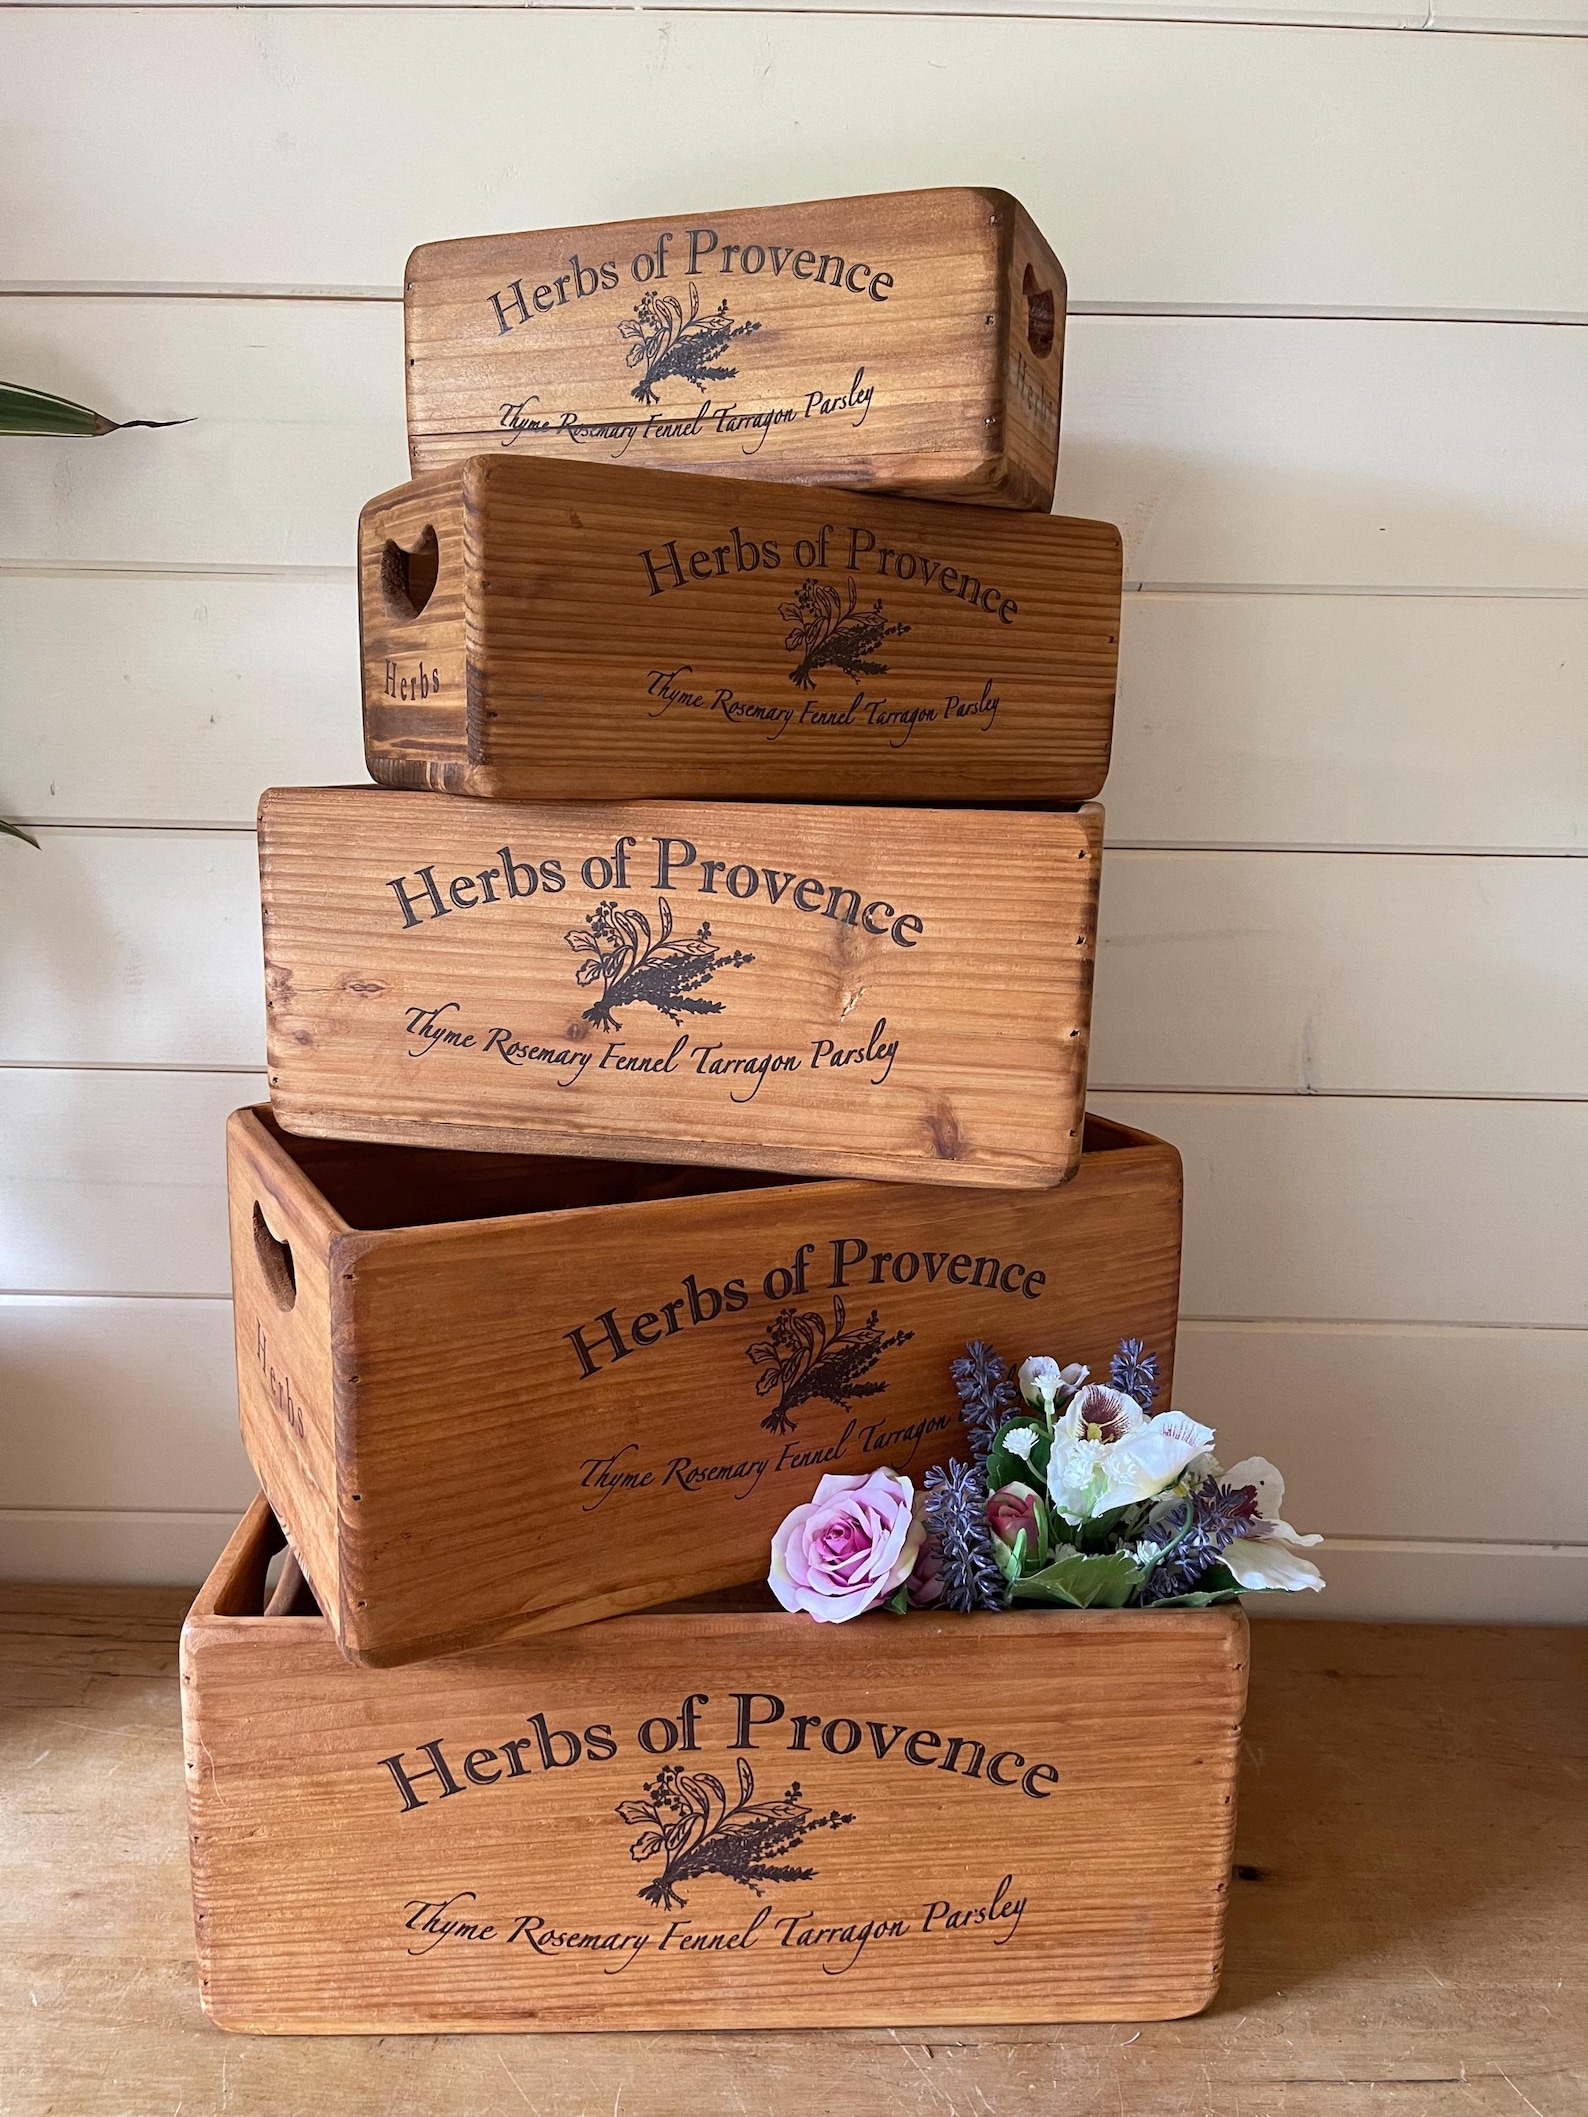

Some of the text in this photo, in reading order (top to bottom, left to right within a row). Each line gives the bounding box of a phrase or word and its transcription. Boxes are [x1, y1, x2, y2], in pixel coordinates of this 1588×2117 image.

[486, 228, 895, 336] Herbs of Provence
[499, 366, 874, 457] Thyme Rosemary Fennel Tarragon Parsley
[639, 526, 1019, 625] Herbs of Provence
[385, 659, 439, 701] Herbs
[647, 664, 1000, 748] Thyme Rosemary Fennel Tarragon Parsley
[386, 836, 925, 948] Herbs of Provence
[405, 1003, 901, 1102] Thyme Rosemary Fennel Tarragon Parsley
[562, 1238, 1047, 1380] Herbs of Provence
[257, 1317, 304, 1438] Herbs
[580, 1412, 951, 1512] Thyme Rosemary Fennel Tarragon
[377, 1693, 1060, 1814] Herbs of Provence
[403, 1874, 1029, 1975] Thyme Rosemary Fennel Tarragon Parsley
